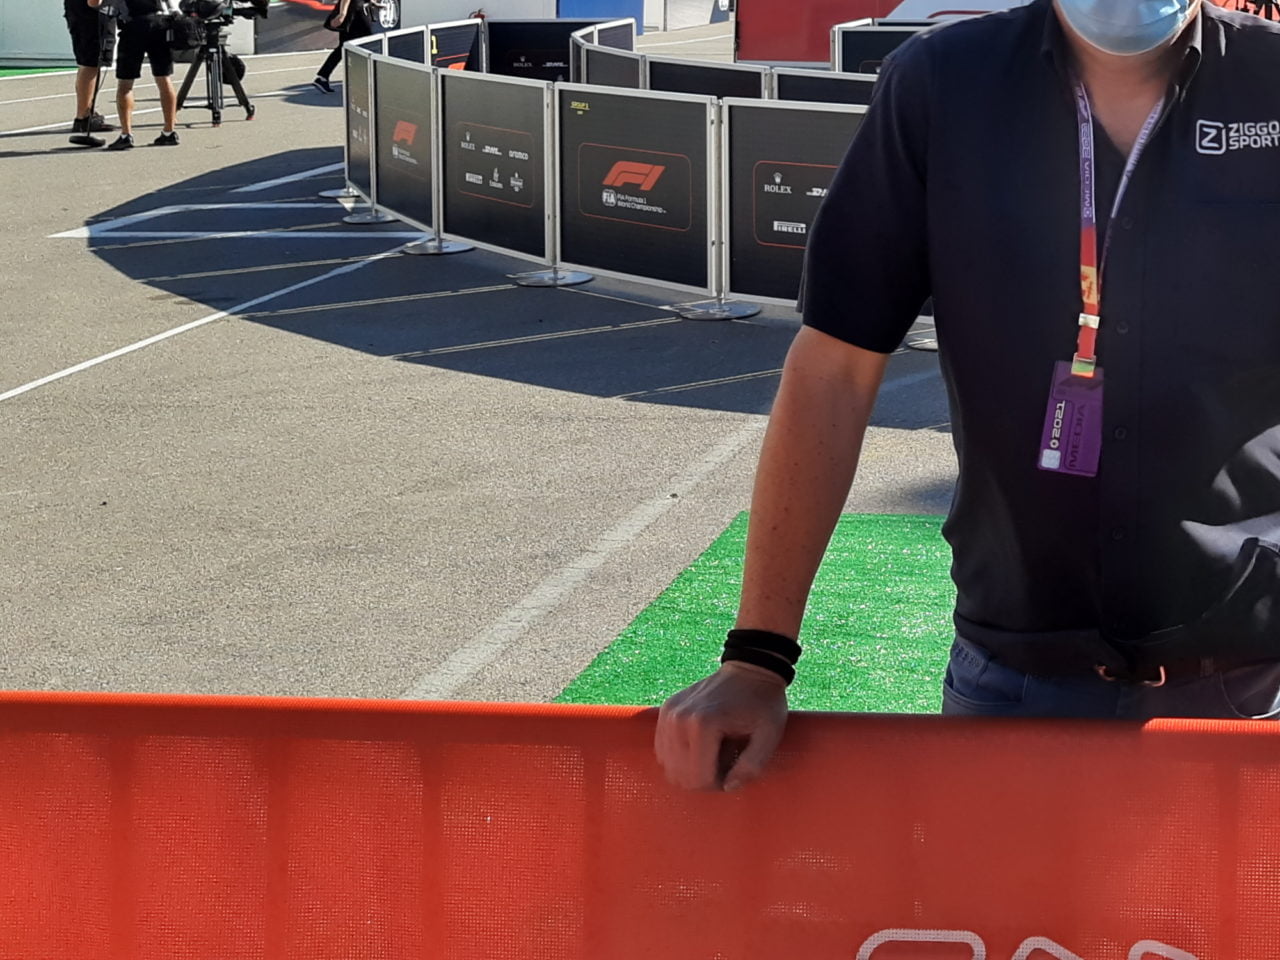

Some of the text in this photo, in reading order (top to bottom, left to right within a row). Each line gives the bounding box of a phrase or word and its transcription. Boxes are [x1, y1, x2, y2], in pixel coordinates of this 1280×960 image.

[1228, 121, 1280, 137] ZIGGO
[1228, 134, 1280, 150] SPORT
[509, 149, 529, 160] aramco
[602, 161, 666, 191] F1
[764, 184, 792, 194] ROLEX
[773, 220, 806, 234] PIRELLI
[1052, 400, 1066, 438] 2021
[1067, 404, 1085, 468] MEDIA
